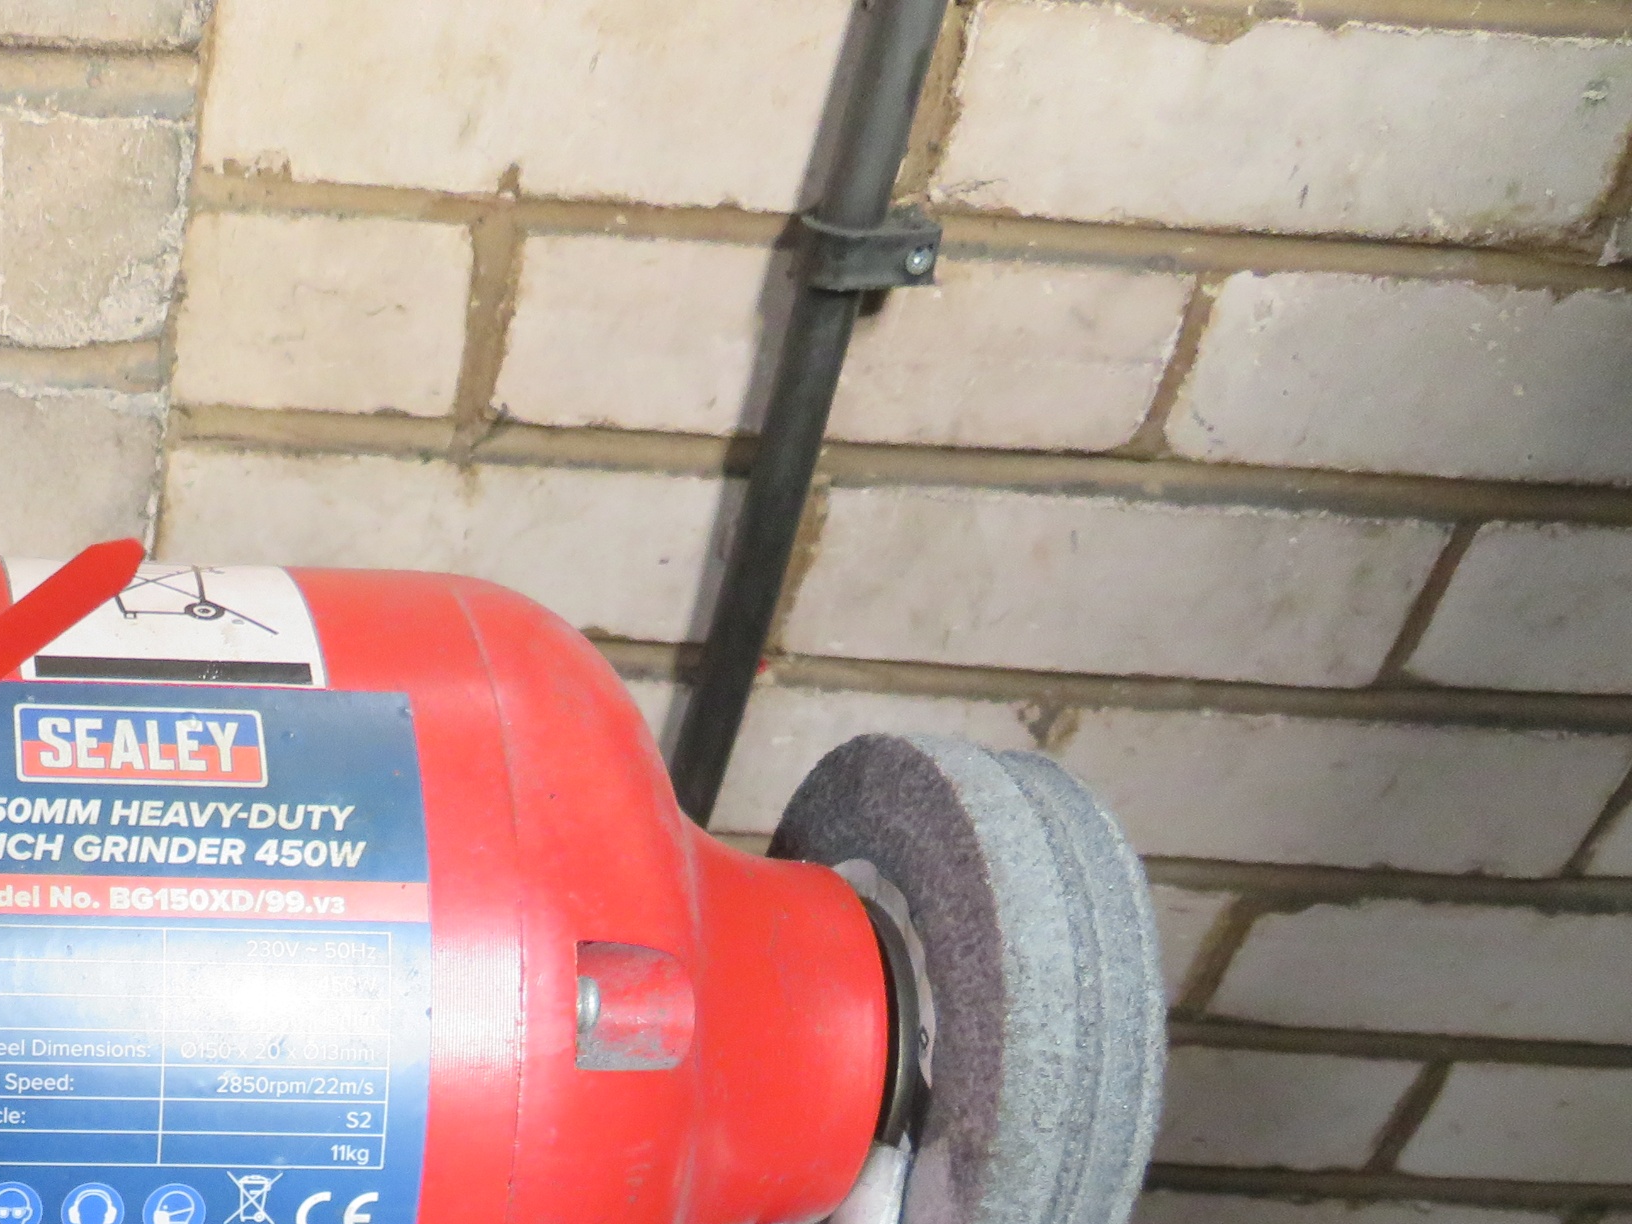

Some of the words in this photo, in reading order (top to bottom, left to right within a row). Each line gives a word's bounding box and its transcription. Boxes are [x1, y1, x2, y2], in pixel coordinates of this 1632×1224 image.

[37, 716, 239, 774] SEALEY
[110, 798, 355, 831] HEAVY-DUTY
[72, 835, 243, 866] GRINDER
[254, 839, 367, 868] 450W
[49, 885, 100, 909] No.
[108, 886, 345, 914] BG150XD/99.v3
[246, 940, 300, 959] 230V
[324, 942, 378, 960] 50Hz
[31, 1038, 152, 1058] Dimensions:
[254, 1042, 281, 1061] 20
[4, 1072, 75, 1094] Speed:
[215, 1075, 375, 1098] 2850rpm/22m/s
[345, 1110, 373, 1130] S2
[330, 1144, 371, 1165] 11kg
